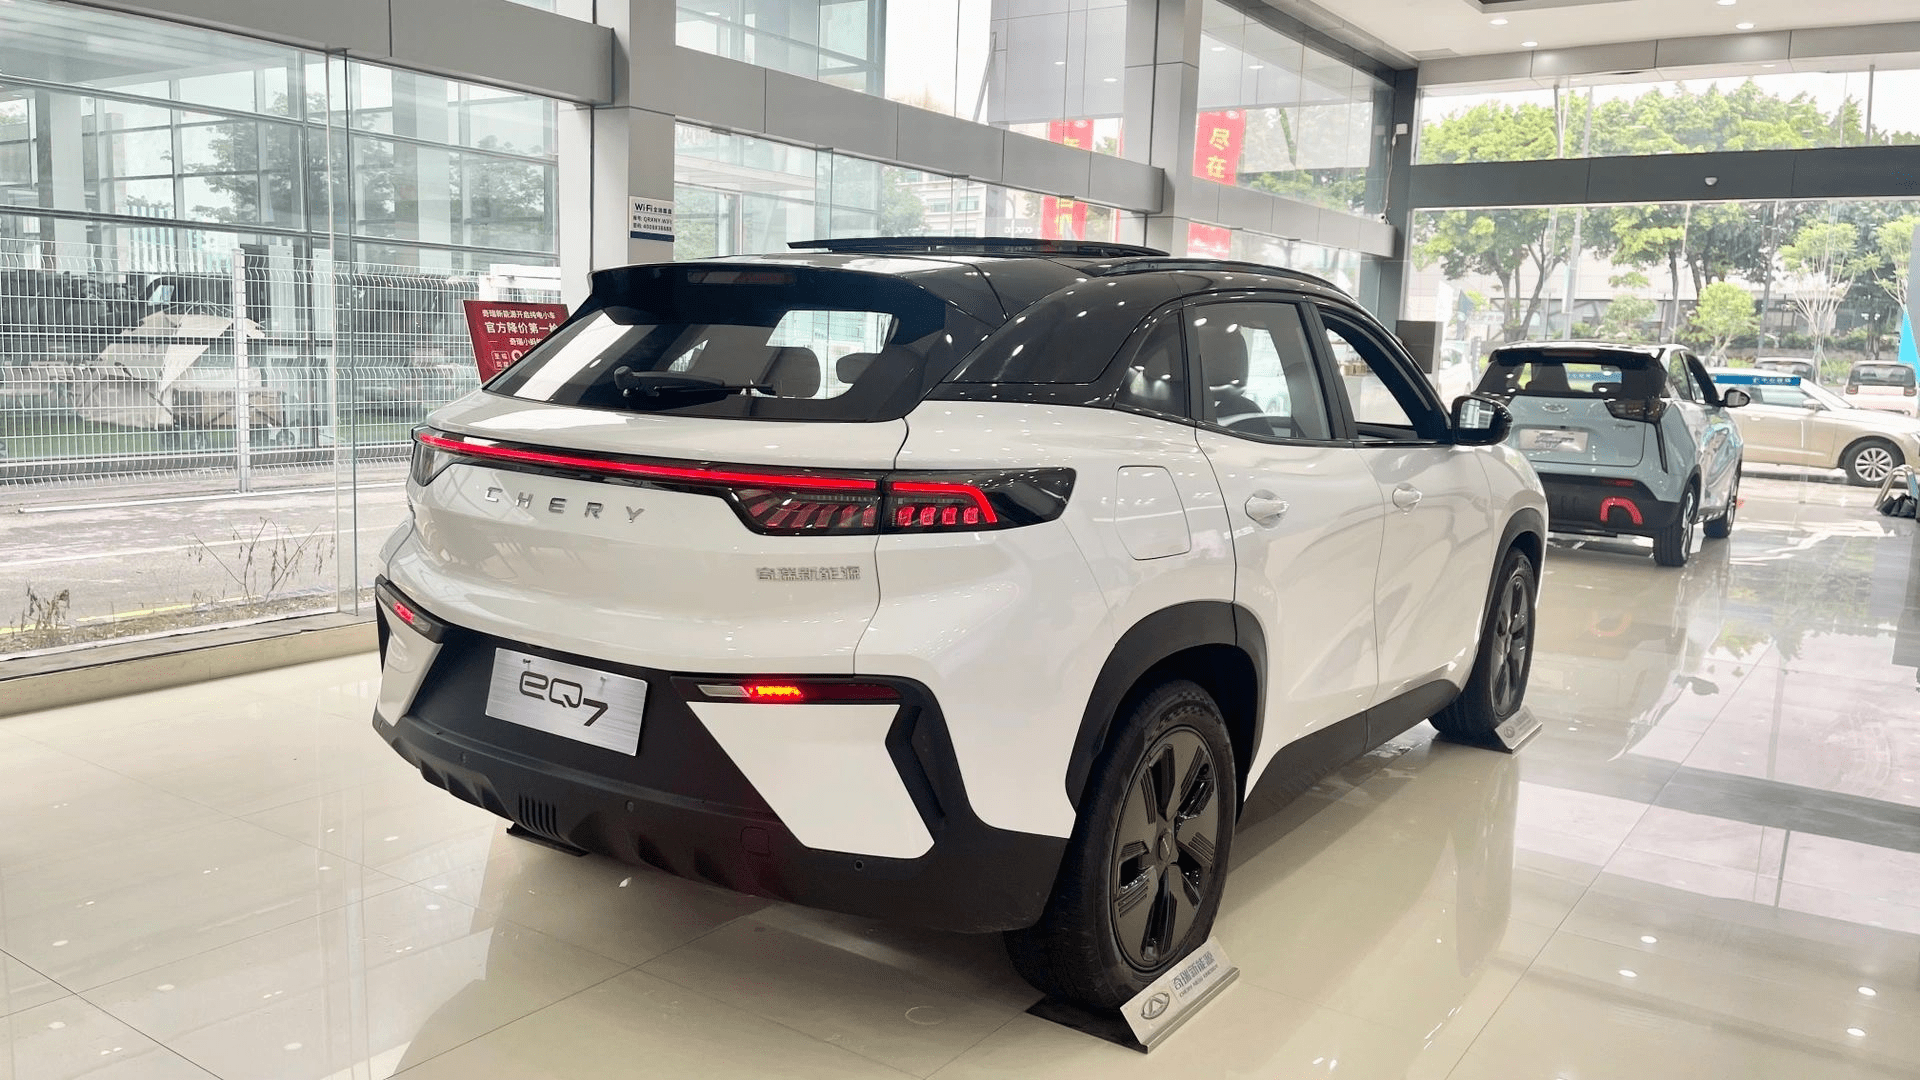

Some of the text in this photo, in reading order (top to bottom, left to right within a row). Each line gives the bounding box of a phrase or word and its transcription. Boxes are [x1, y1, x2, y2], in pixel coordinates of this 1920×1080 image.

[634, 203, 652, 211] WiFi
[484, 487, 645, 523] CHERY
[756, 565, 861, 581] 奇瑞新能源
[1171, 951, 1214, 990] 奇瑞新能源
